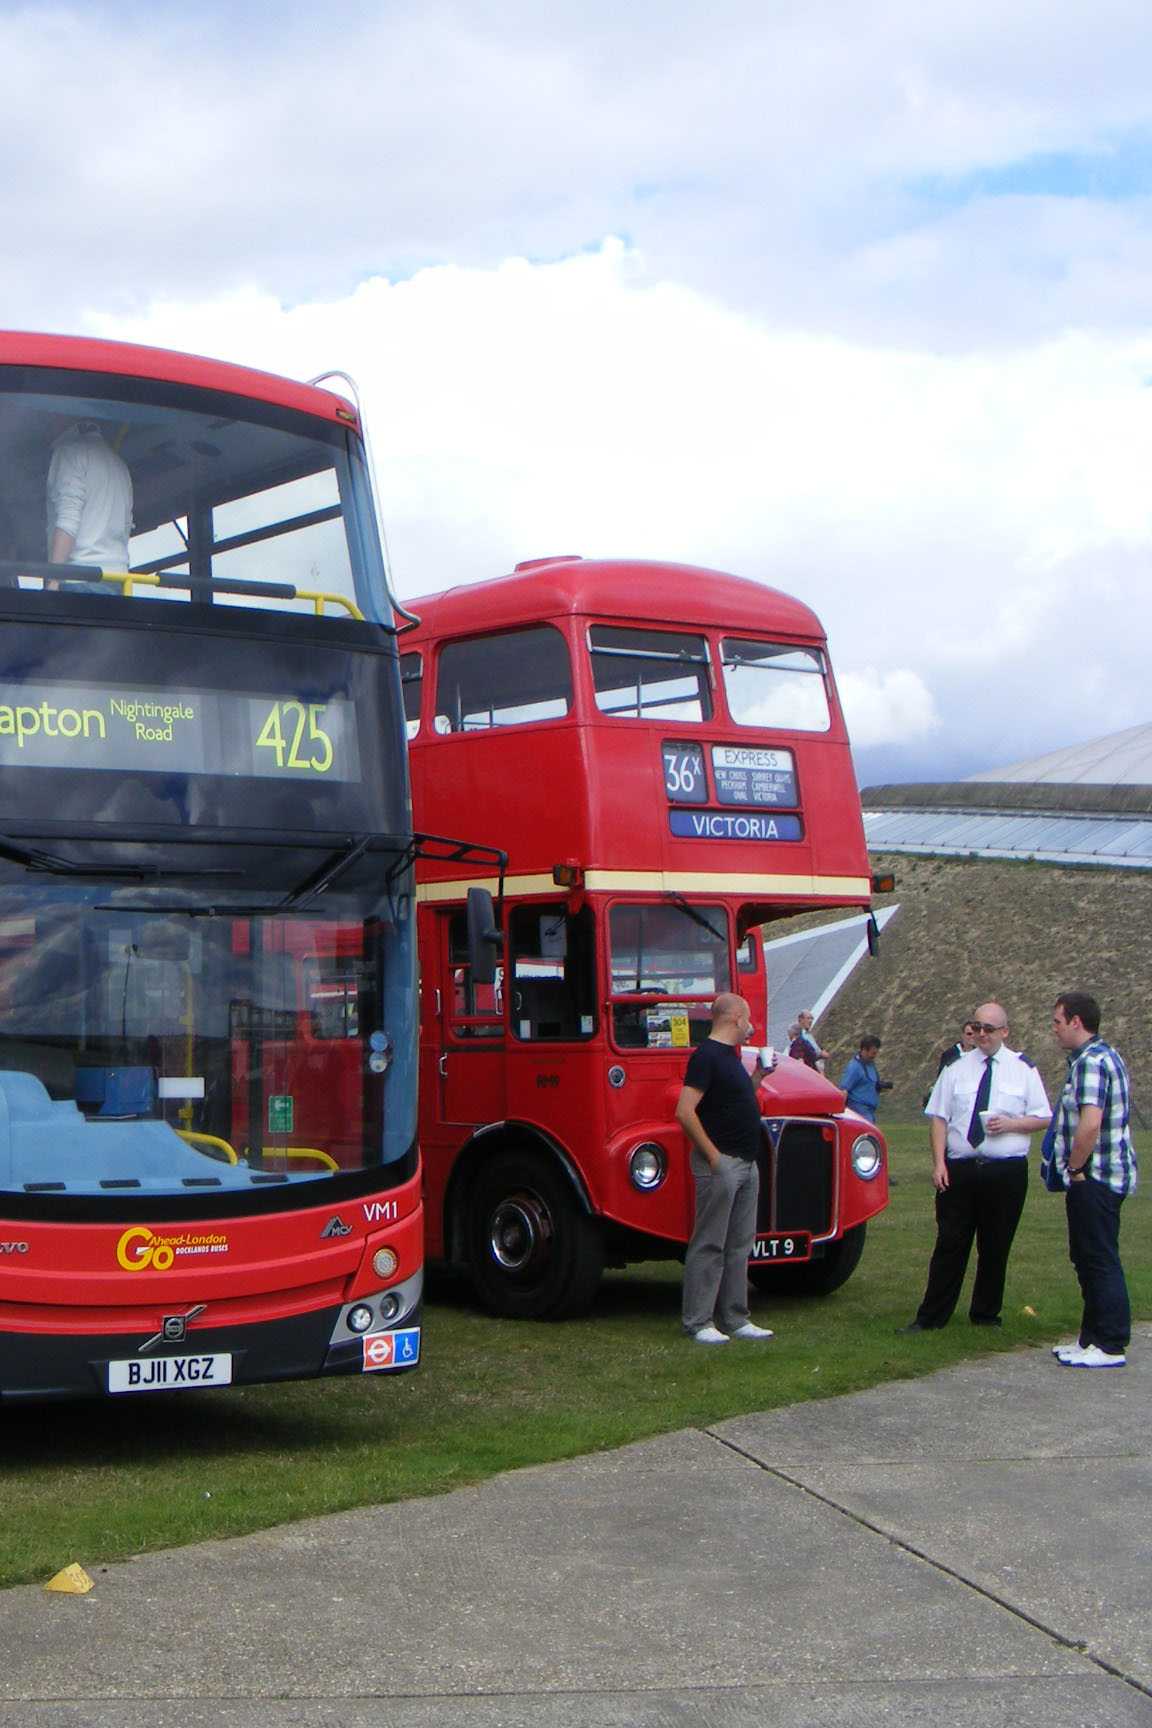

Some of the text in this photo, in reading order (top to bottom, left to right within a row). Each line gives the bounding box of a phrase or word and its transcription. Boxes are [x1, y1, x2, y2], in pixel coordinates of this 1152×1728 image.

[110, 698, 195, 723] Nightingale
[135, 723, 174, 742] Road
[256, 700, 334, 772] 425
[725, 749, 778, 767] EXPRESS
[692, 815, 779, 839] VICTORIA
[363, 1201, 397, 1222] VM1
[116, 1226, 227, 1271] Go Ahead-London
[175, 1243, 228, 1255] DOCKLANDS BUSES
[752, 1238, 794, 1257] VLT 9
[128, 1357, 214, 1385] BJ11 XGZ
